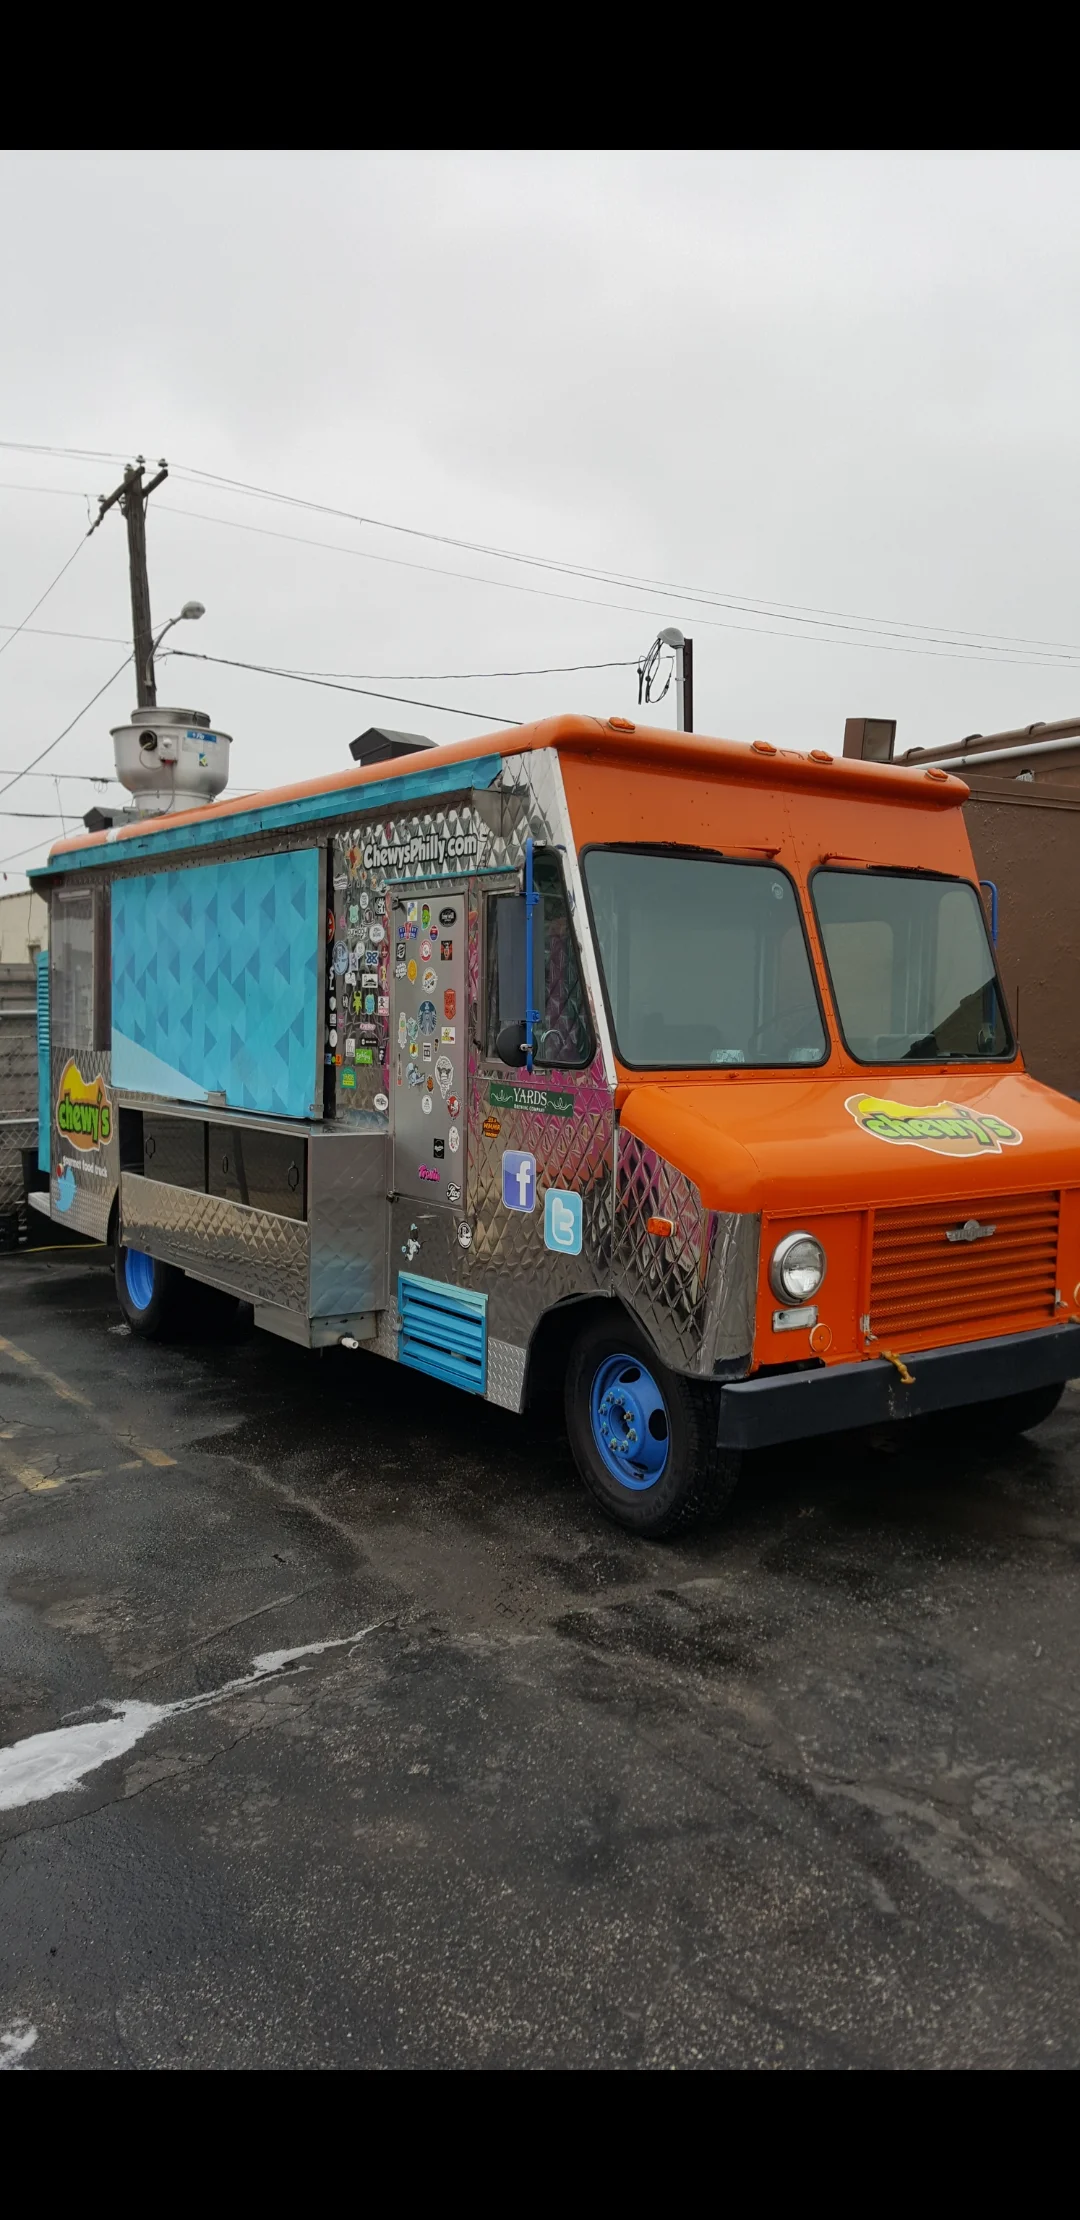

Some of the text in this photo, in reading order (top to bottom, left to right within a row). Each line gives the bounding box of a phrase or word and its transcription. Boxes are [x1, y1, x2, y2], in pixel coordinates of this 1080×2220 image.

[363, 834, 477, 869] ChewysPhilly.com
[513, 1088, 548, 1106] YARDS
[58, 1091, 111, 1144] chewy's
[862, 1110, 1017, 1147] chewy's
[62, 1155, 108, 1178] gourmet food truck
